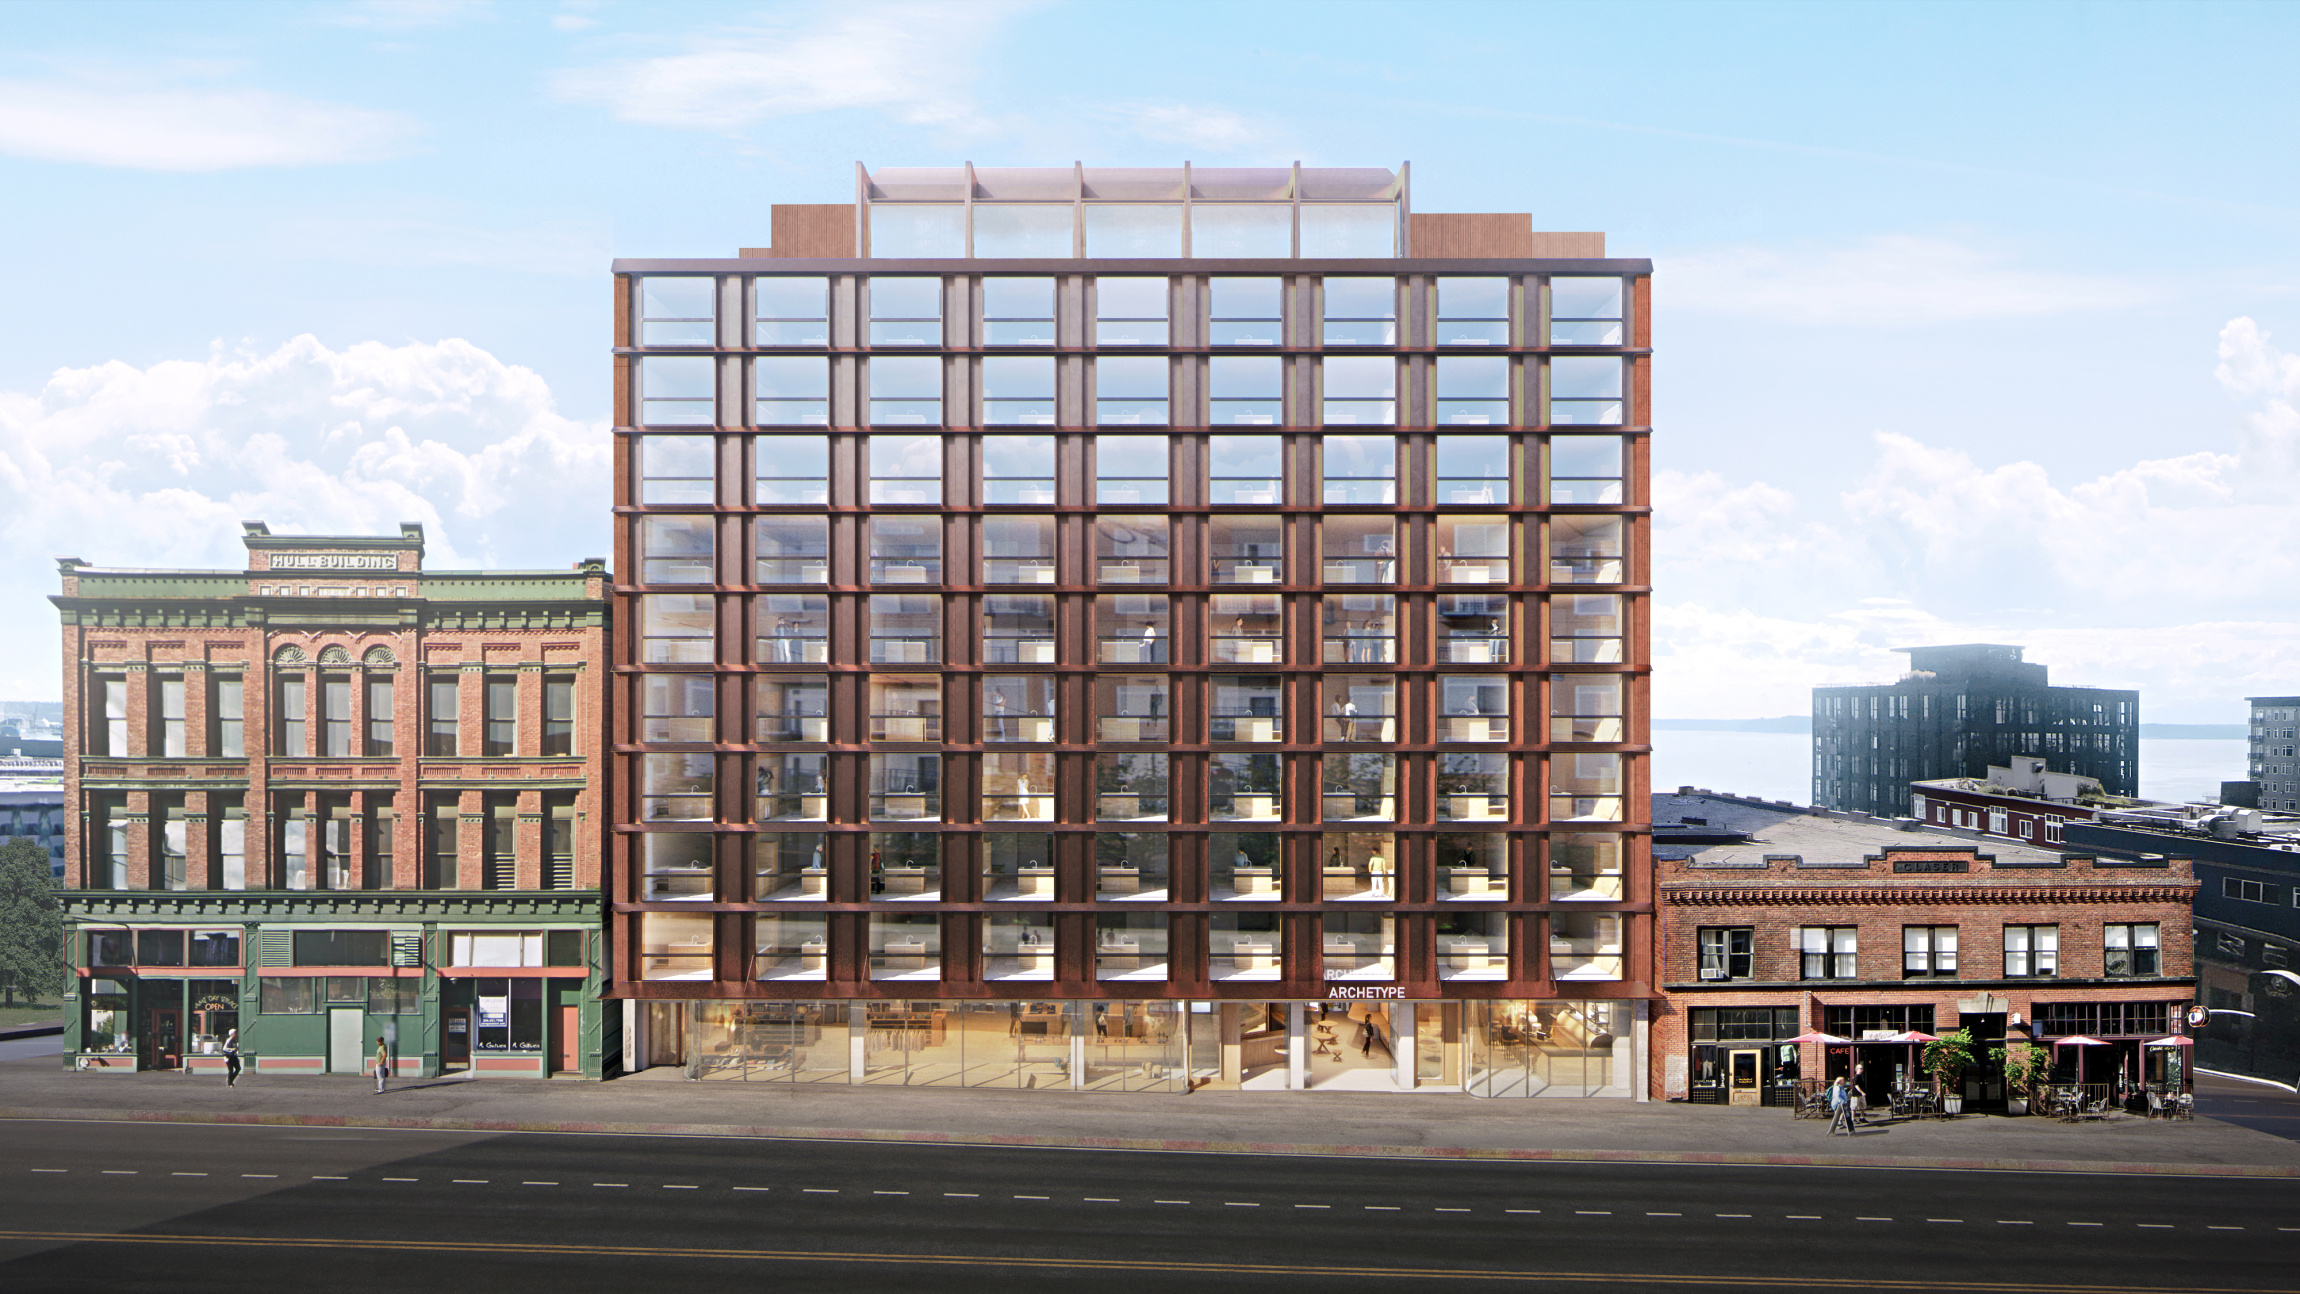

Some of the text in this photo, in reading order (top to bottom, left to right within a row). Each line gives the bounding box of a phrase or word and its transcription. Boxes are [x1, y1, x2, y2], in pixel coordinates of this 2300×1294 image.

[274, 555, 394, 569] HULL BUILDING
[1329, 986, 1406, 999] ARCHETYPE
[204, 1002, 225, 1011] OPEN
[1829, 1047, 1850, 1055] CAFE
